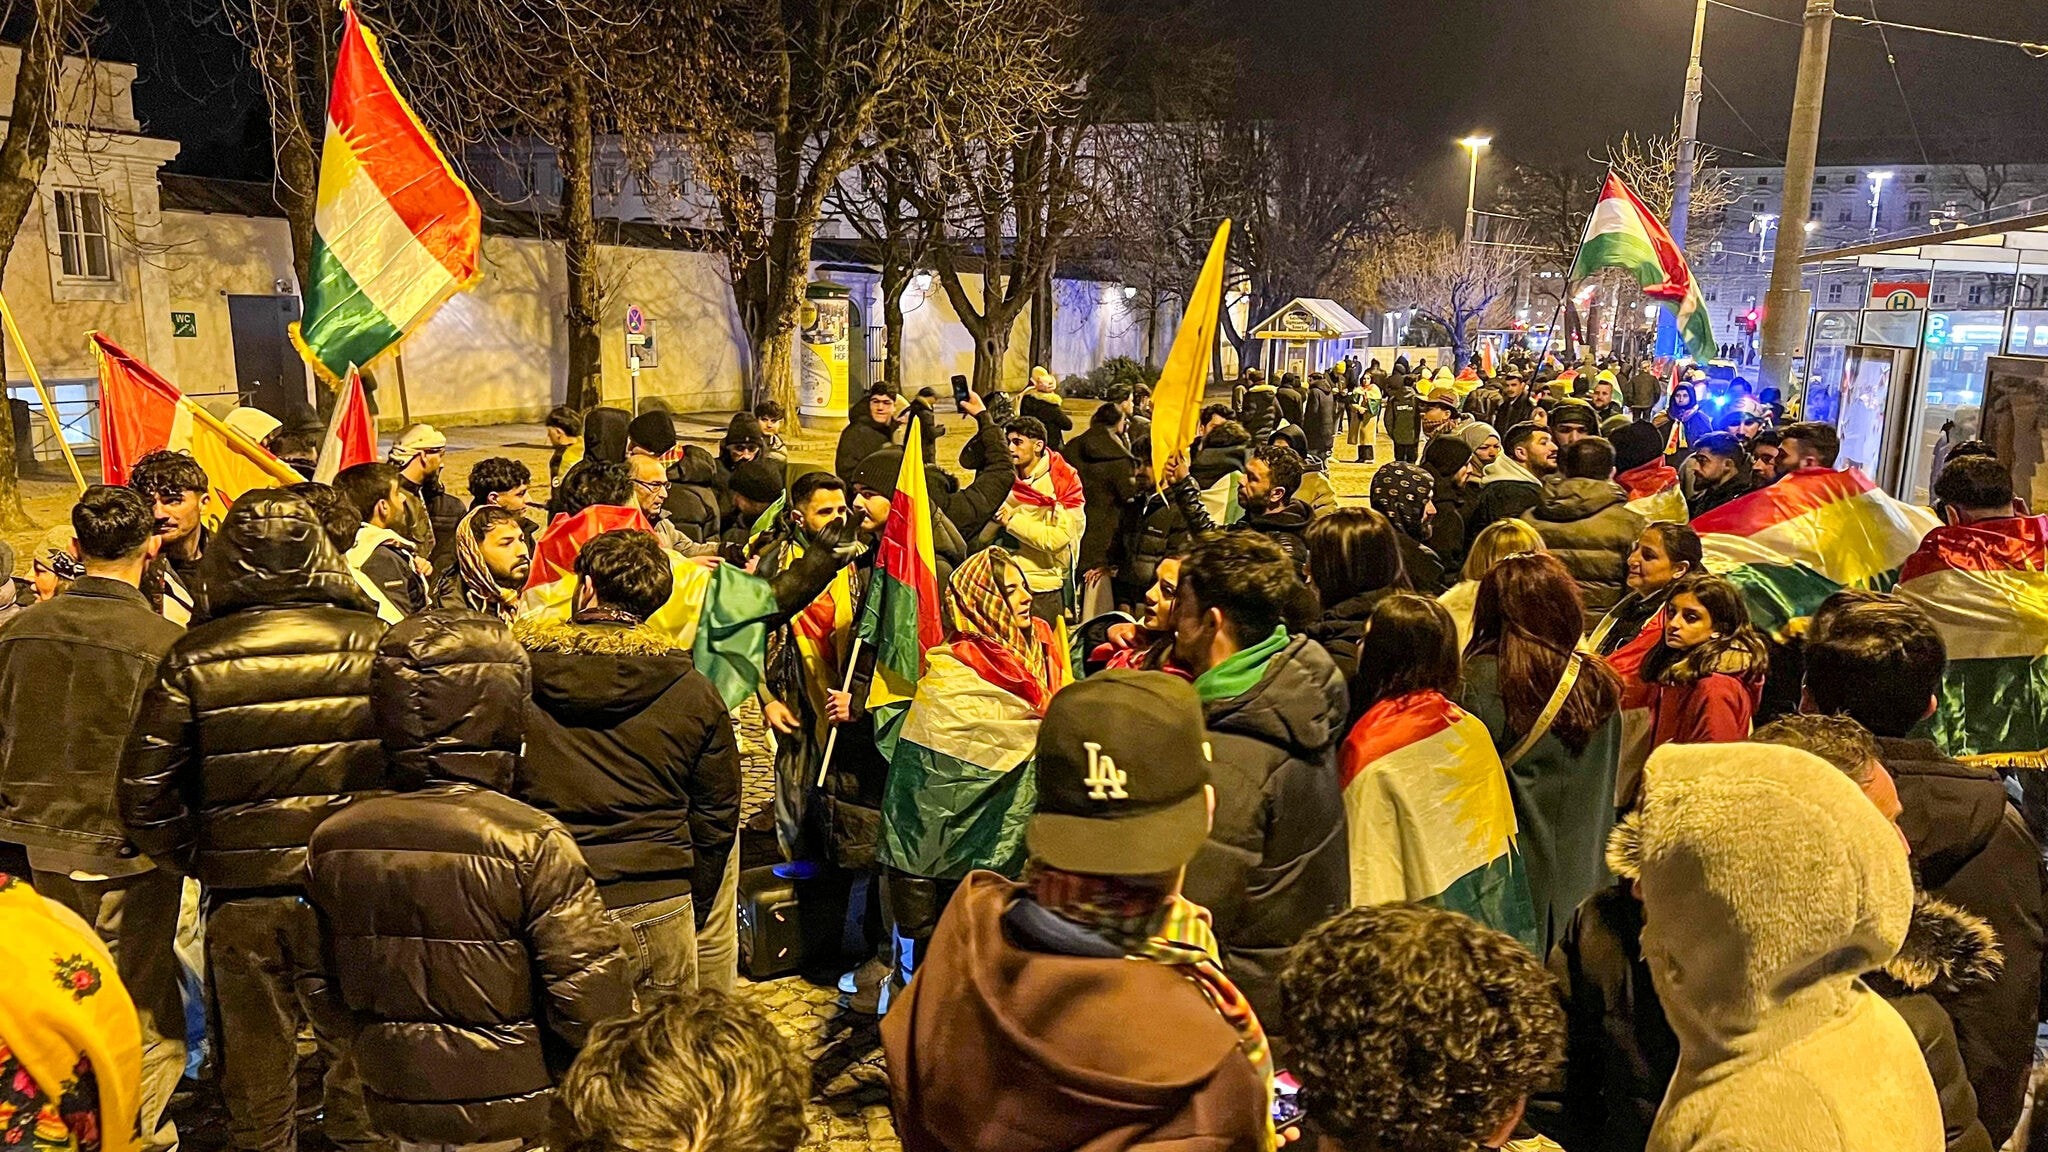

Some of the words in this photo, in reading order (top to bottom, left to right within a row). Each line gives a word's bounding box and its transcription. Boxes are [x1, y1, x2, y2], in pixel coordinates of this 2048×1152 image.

[1894, 296, 1908, 310] H
[175, 314, 191, 323] WC
[1083, 742, 1129, 800] LA
